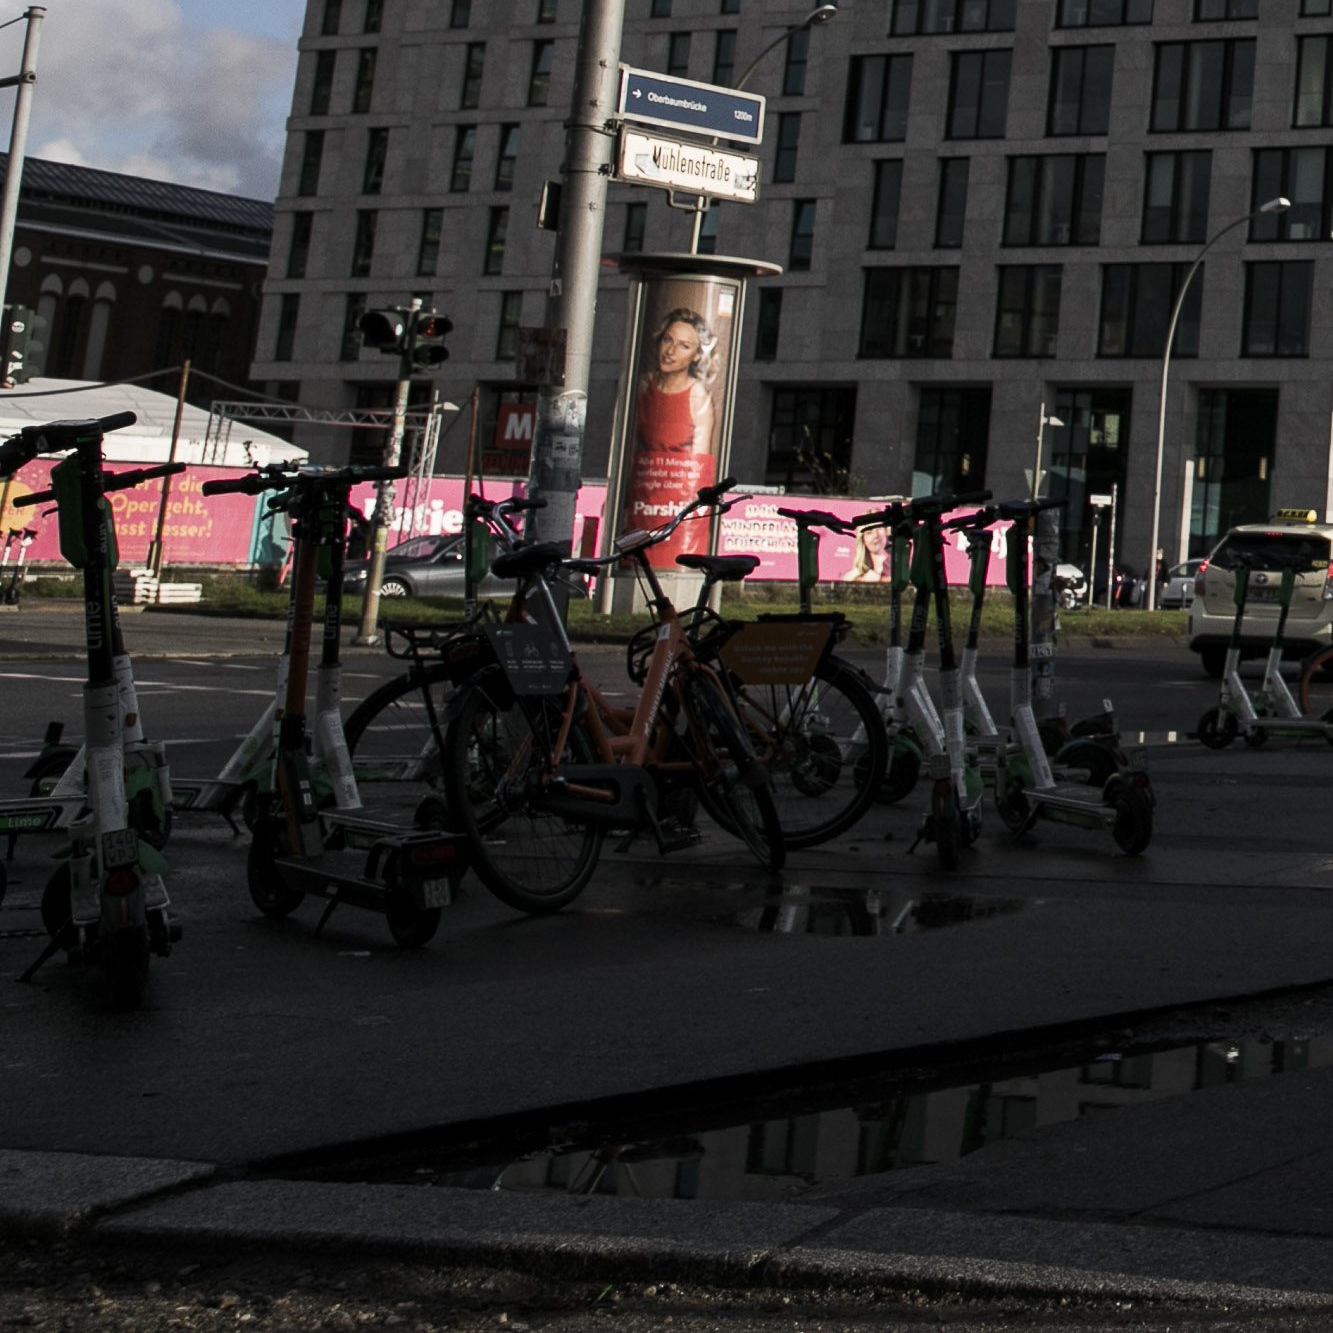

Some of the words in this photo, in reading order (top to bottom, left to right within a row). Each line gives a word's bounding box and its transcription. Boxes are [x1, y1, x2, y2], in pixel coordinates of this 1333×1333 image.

[647, 91, 708, 113] Oberbaumbrücke
[653, 144, 731, 182] Mühlenstraße
[503, 411, 532, 441] M
[85, 599, 103, 651] Lime
[8, 816, 42, 828] Lime
